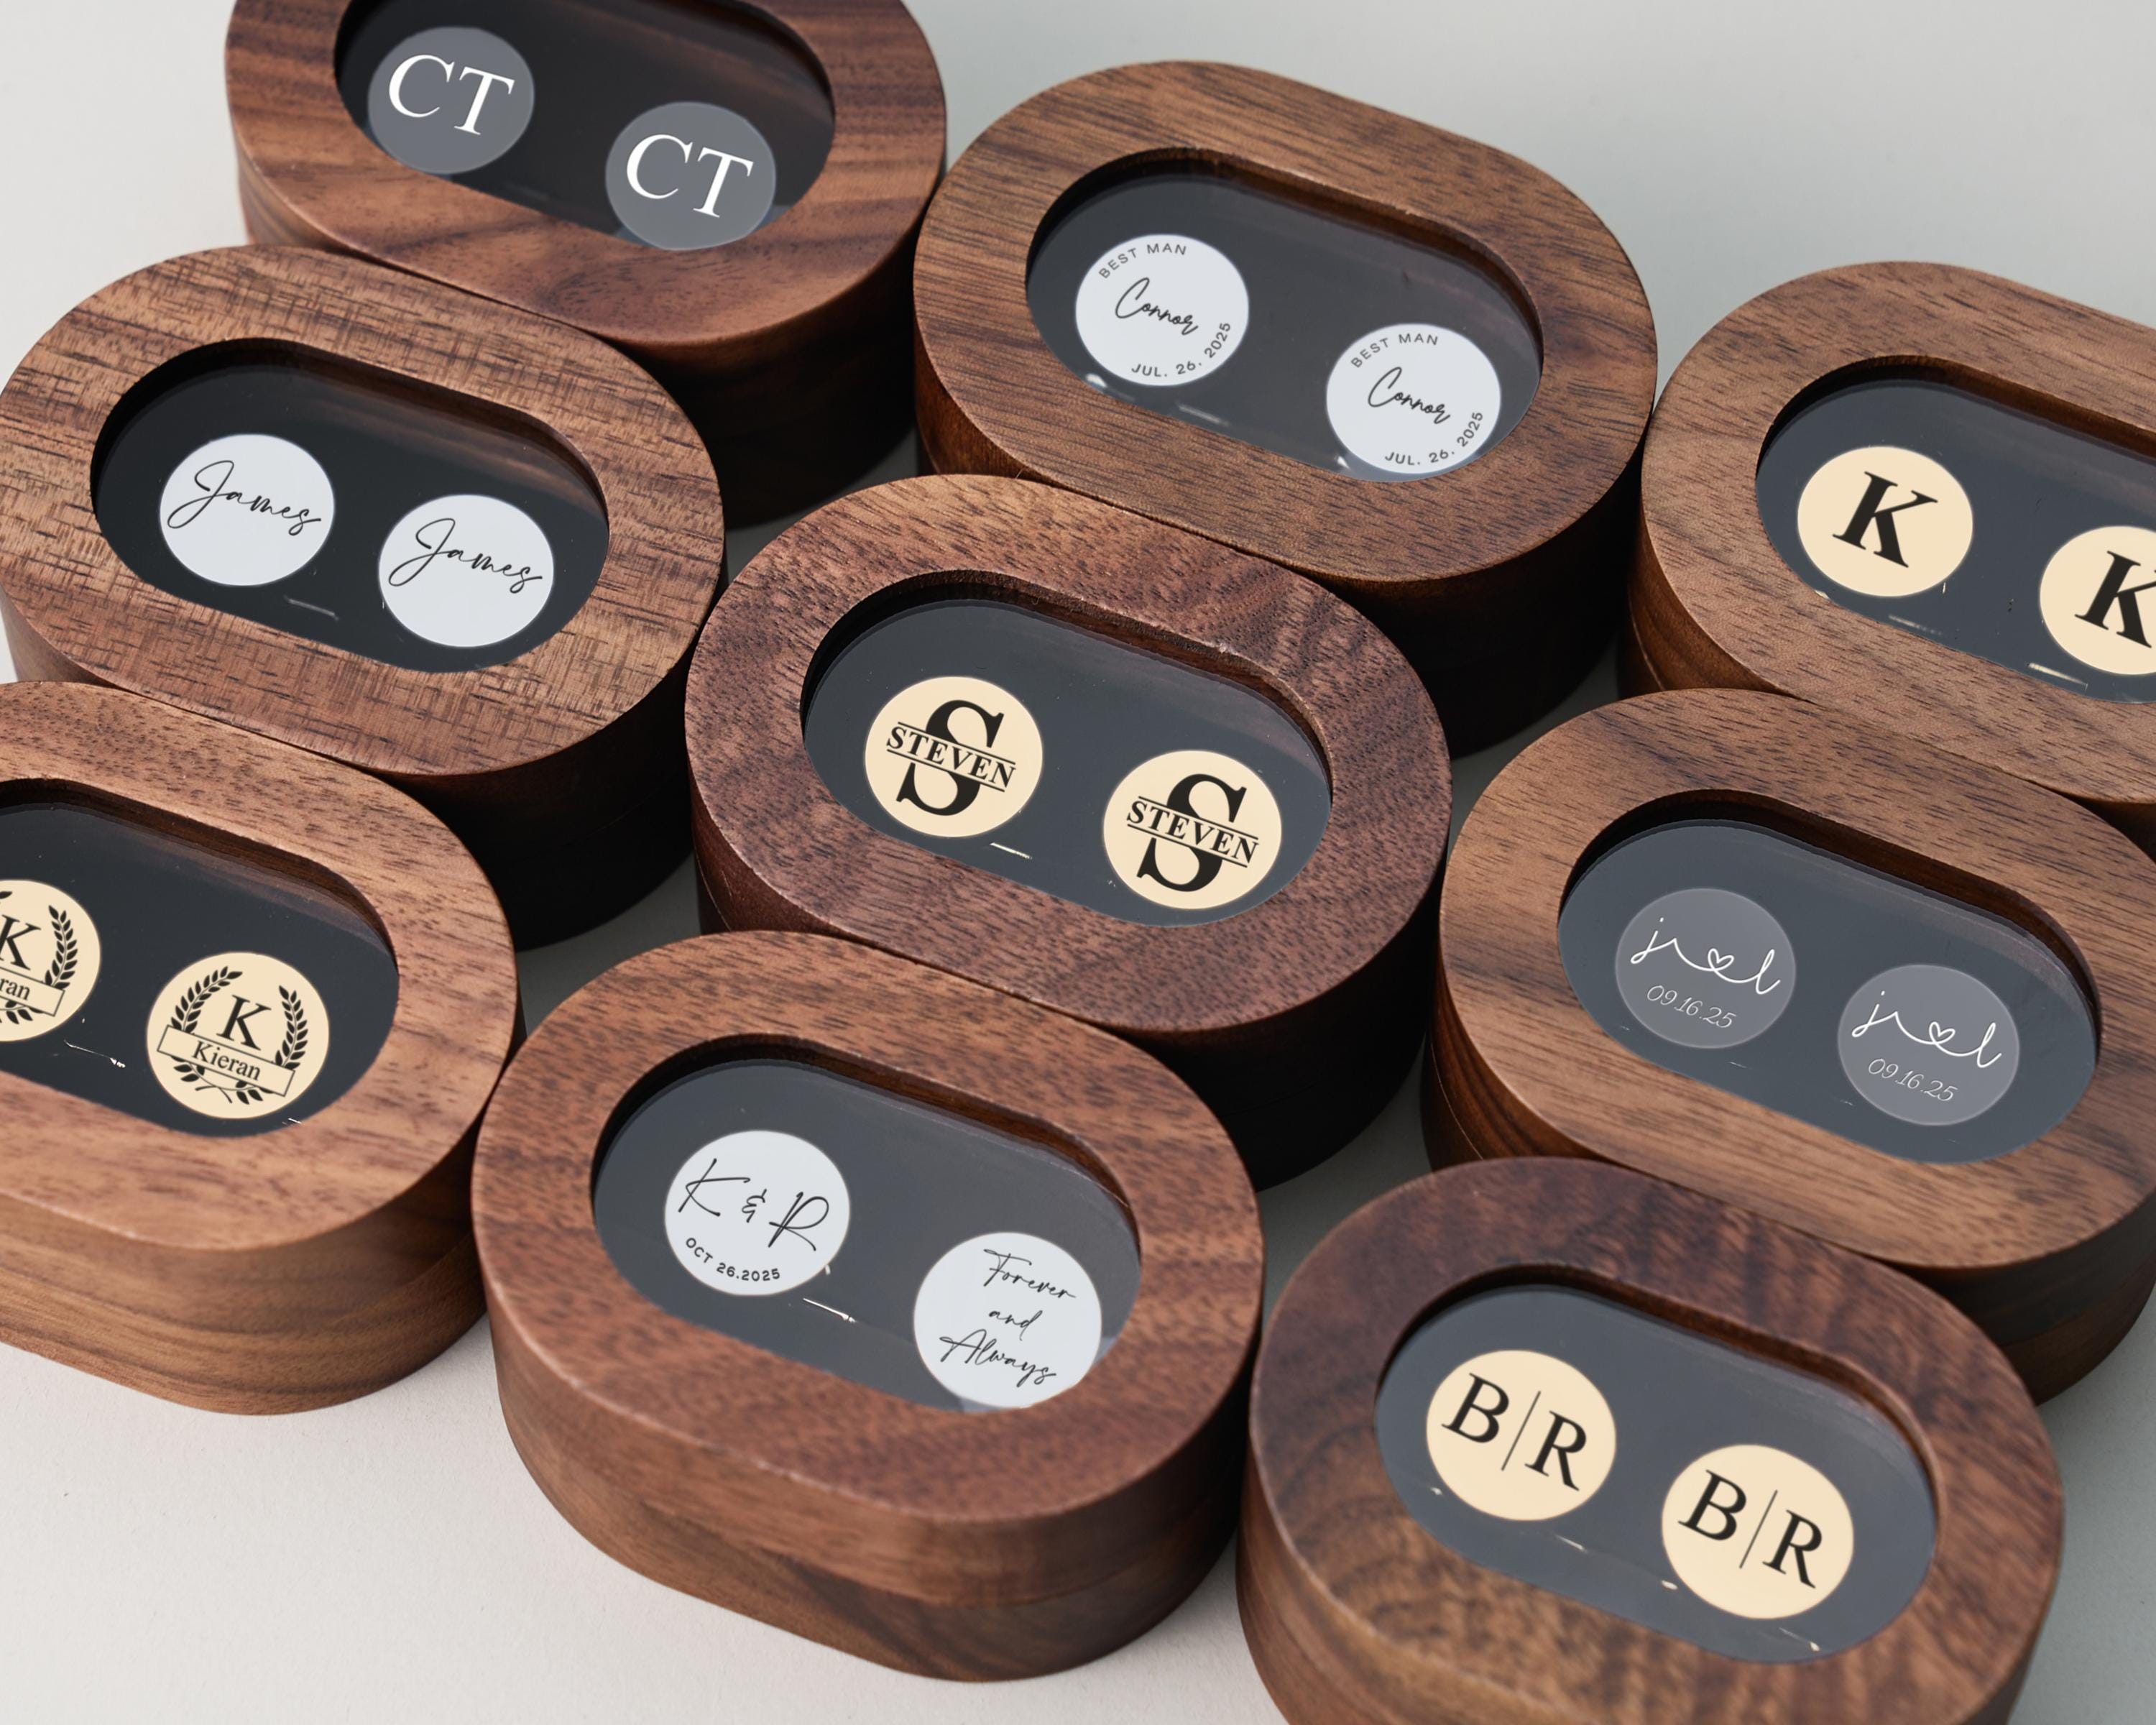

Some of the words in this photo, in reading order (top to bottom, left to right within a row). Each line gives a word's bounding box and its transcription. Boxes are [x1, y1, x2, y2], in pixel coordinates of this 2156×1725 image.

[389, 54, 515, 135] CT
[626, 134, 753, 218] CT
[1098, 248, 1138, 278] BEST
[1147, 243, 1187, 255] MAN
[1115, 277, 1199, 335] Connor
[1131, 364, 1167, 377] JUL.
[1204, 322, 1231, 359] 2025
[1350, 337, 1389, 368] BEST
[1399, 333, 1439, 346] MAN
[1368, 367, 1450, 424] Connor
[1385, 451, 1420, 465] JUL.
[1457, 412, 1483, 447] 2025
[167, 459, 321, 536] James
[1833, 471, 1938, 569] K
[388, 518, 543, 594] James
[2075, 551, 2156, 648] K
[886, 725, 1017, 788] STEVEN
[895, 699, 1004, 816] S
[1126, 799, 1260, 863] STEVEN
[1136, 773, 1247, 892] S
[0, 914, 41, 970] K
[216, 995, 271, 1051] K
[1646, 985, 1737, 1029] 09.16.25
[192, 1041, 262, 1081] Kieran
[1868, 1058, 1958, 1102] 09.16.25
[678, 1158, 751, 1217] K
[741, 1188, 768, 1223] &
[768, 1192, 829, 1251] R
[685, 1236, 714, 1264] OCT
[716, 1261, 781, 1282] 26.2025
[983, 1248, 1077, 1300] Forever
[987, 1310, 1043, 1342] and
[939, 1328, 1057, 1387] Always
